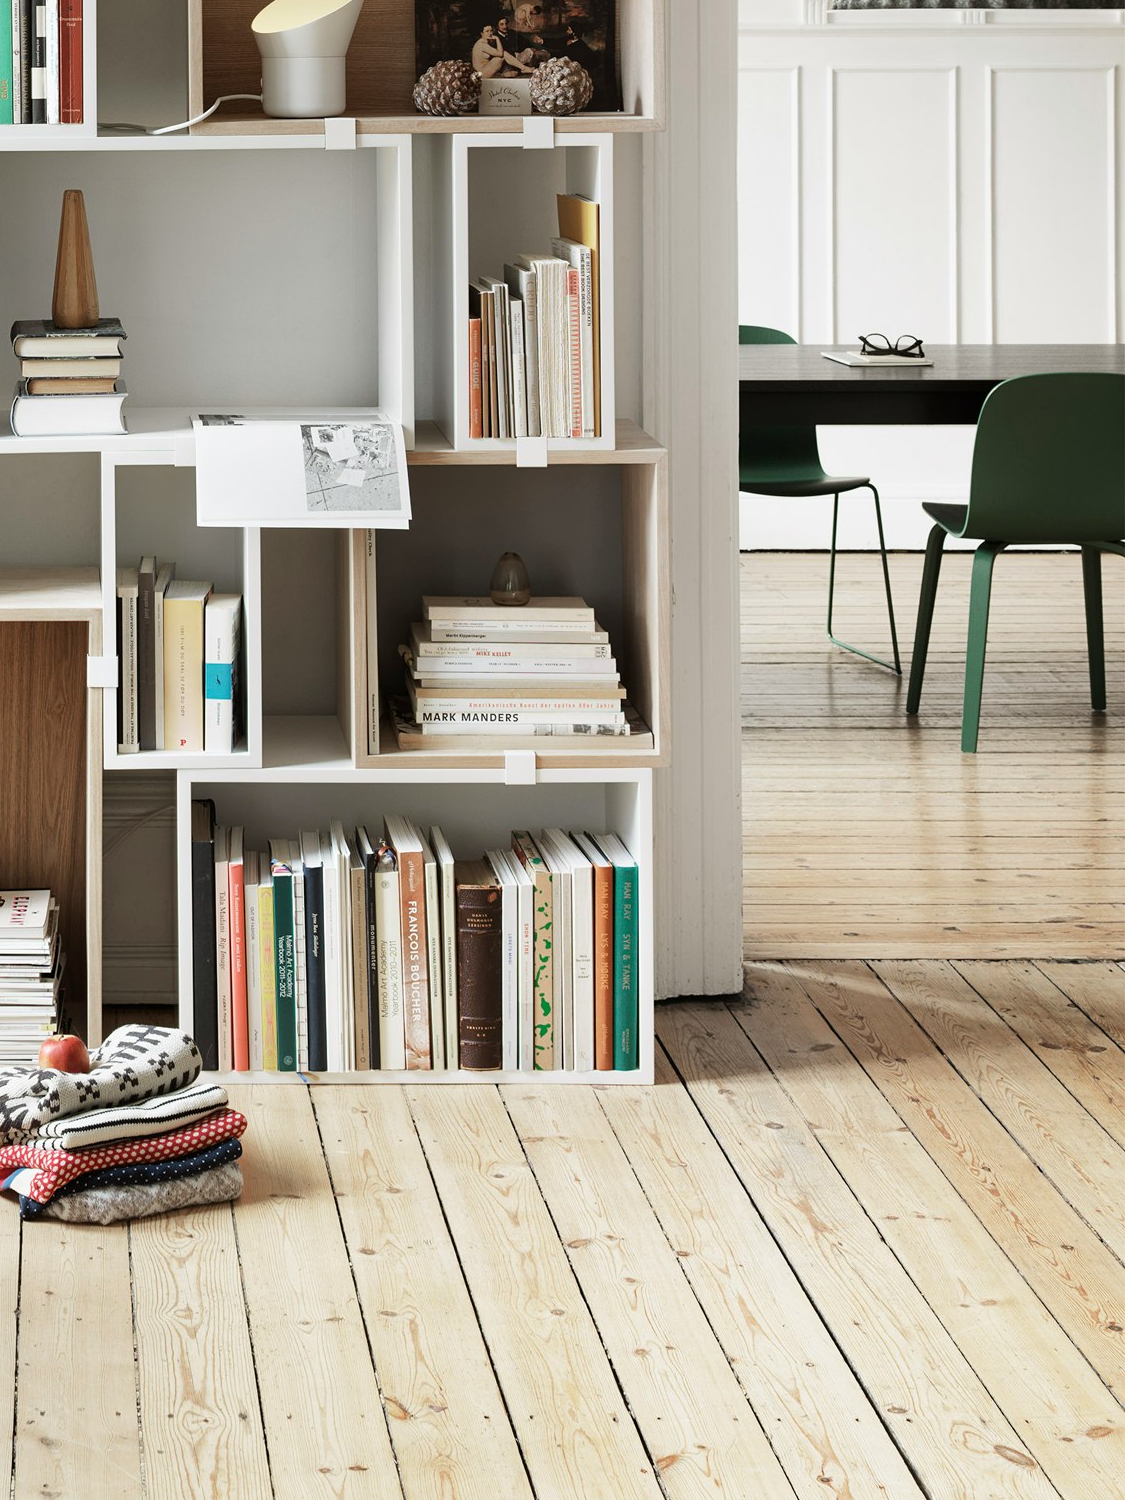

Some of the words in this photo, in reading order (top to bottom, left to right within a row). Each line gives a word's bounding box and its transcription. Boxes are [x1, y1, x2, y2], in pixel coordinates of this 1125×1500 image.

[422, 712, 457, 722] MARK
[461, 713, 519, 722] MANDERS
[285, 935, 293, 956] Malmö
[407, 901, 419, 961] FRANÇOIS
[285, 969, 293, 998] Academy
[410, 964, 420, 1022] BOUCHER
